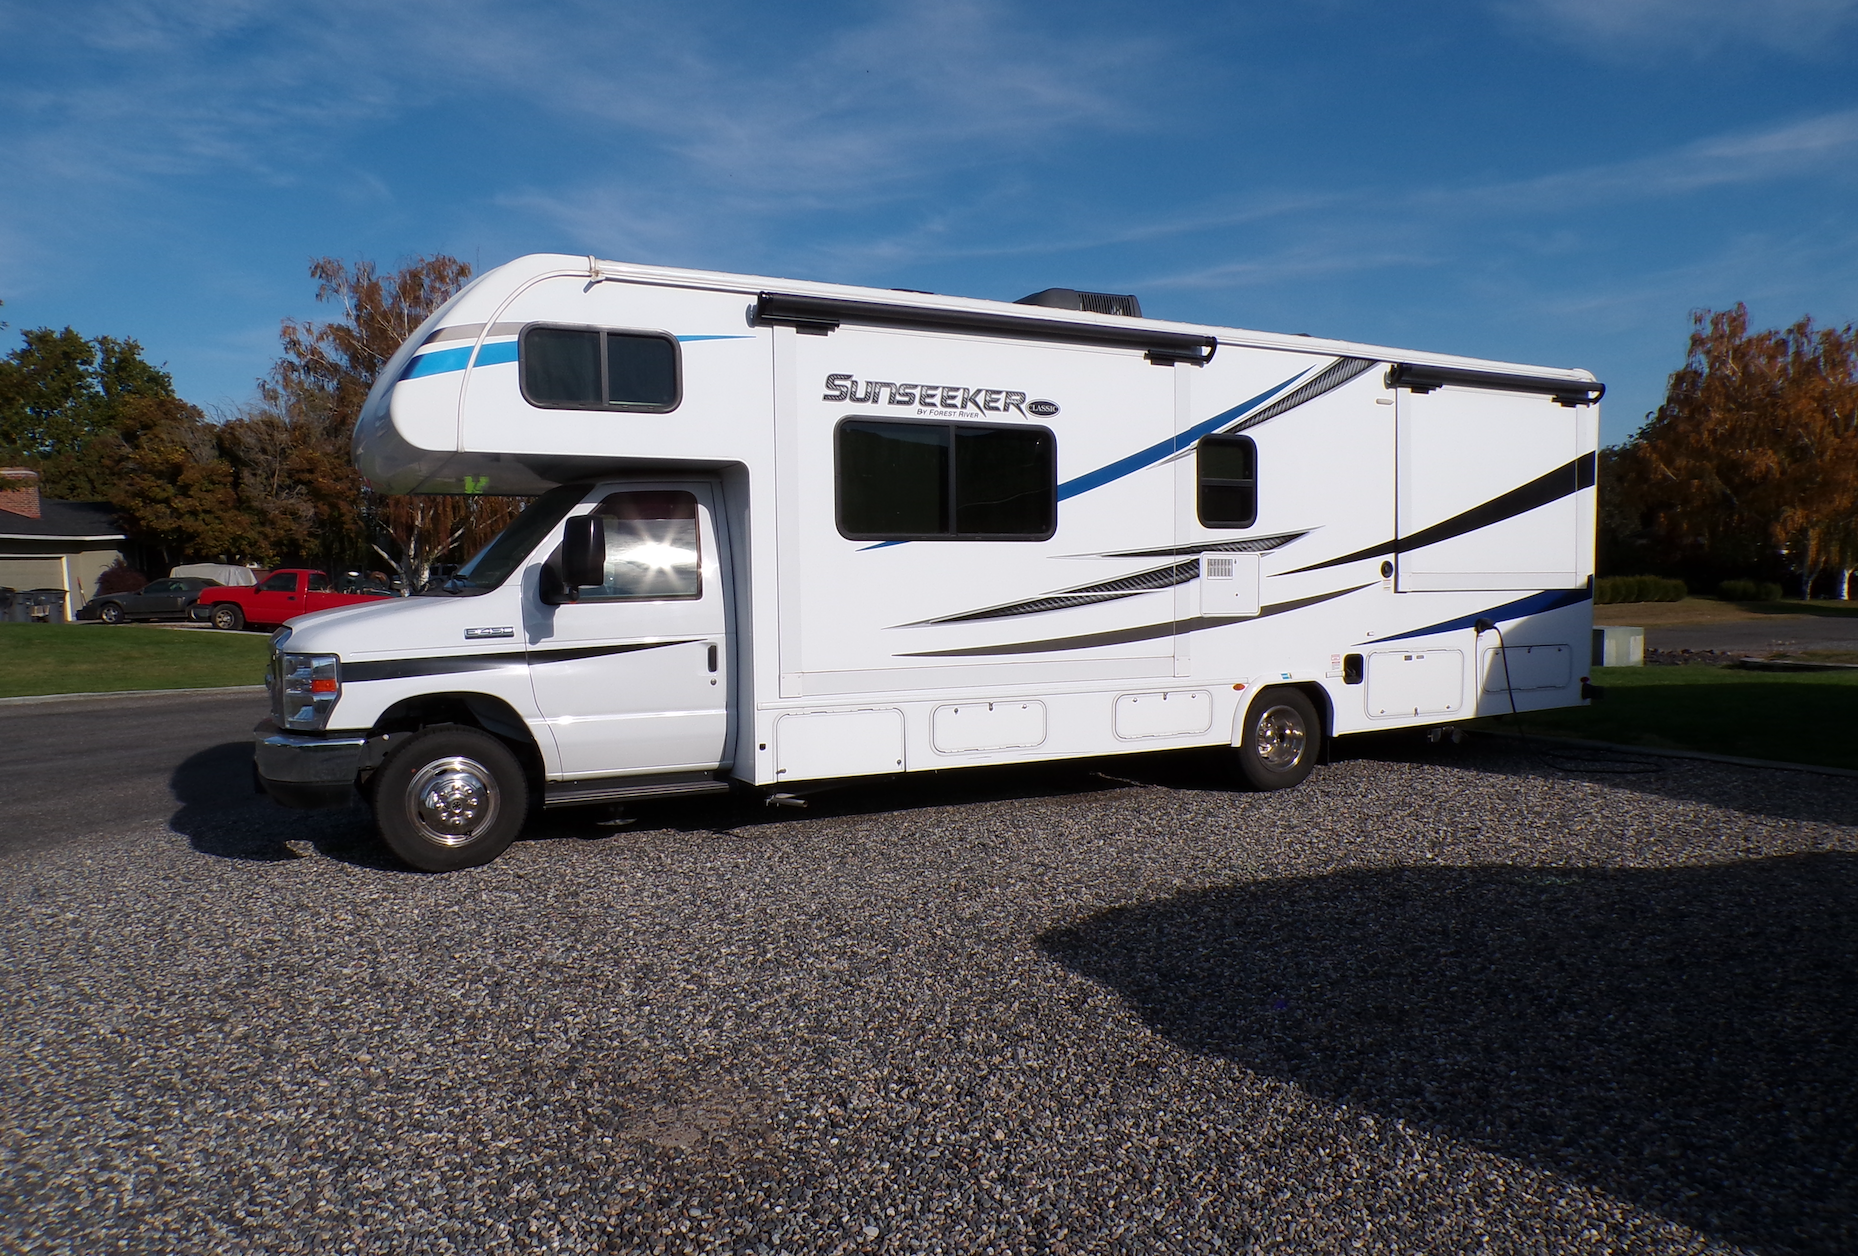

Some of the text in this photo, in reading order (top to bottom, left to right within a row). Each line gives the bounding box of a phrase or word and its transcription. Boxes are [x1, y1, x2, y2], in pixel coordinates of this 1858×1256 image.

[822, 373, 1029, 420] SUNSEEKER
[928, 408, 957, 417] FOREST
[958, 410, 980, 418] RIVER
